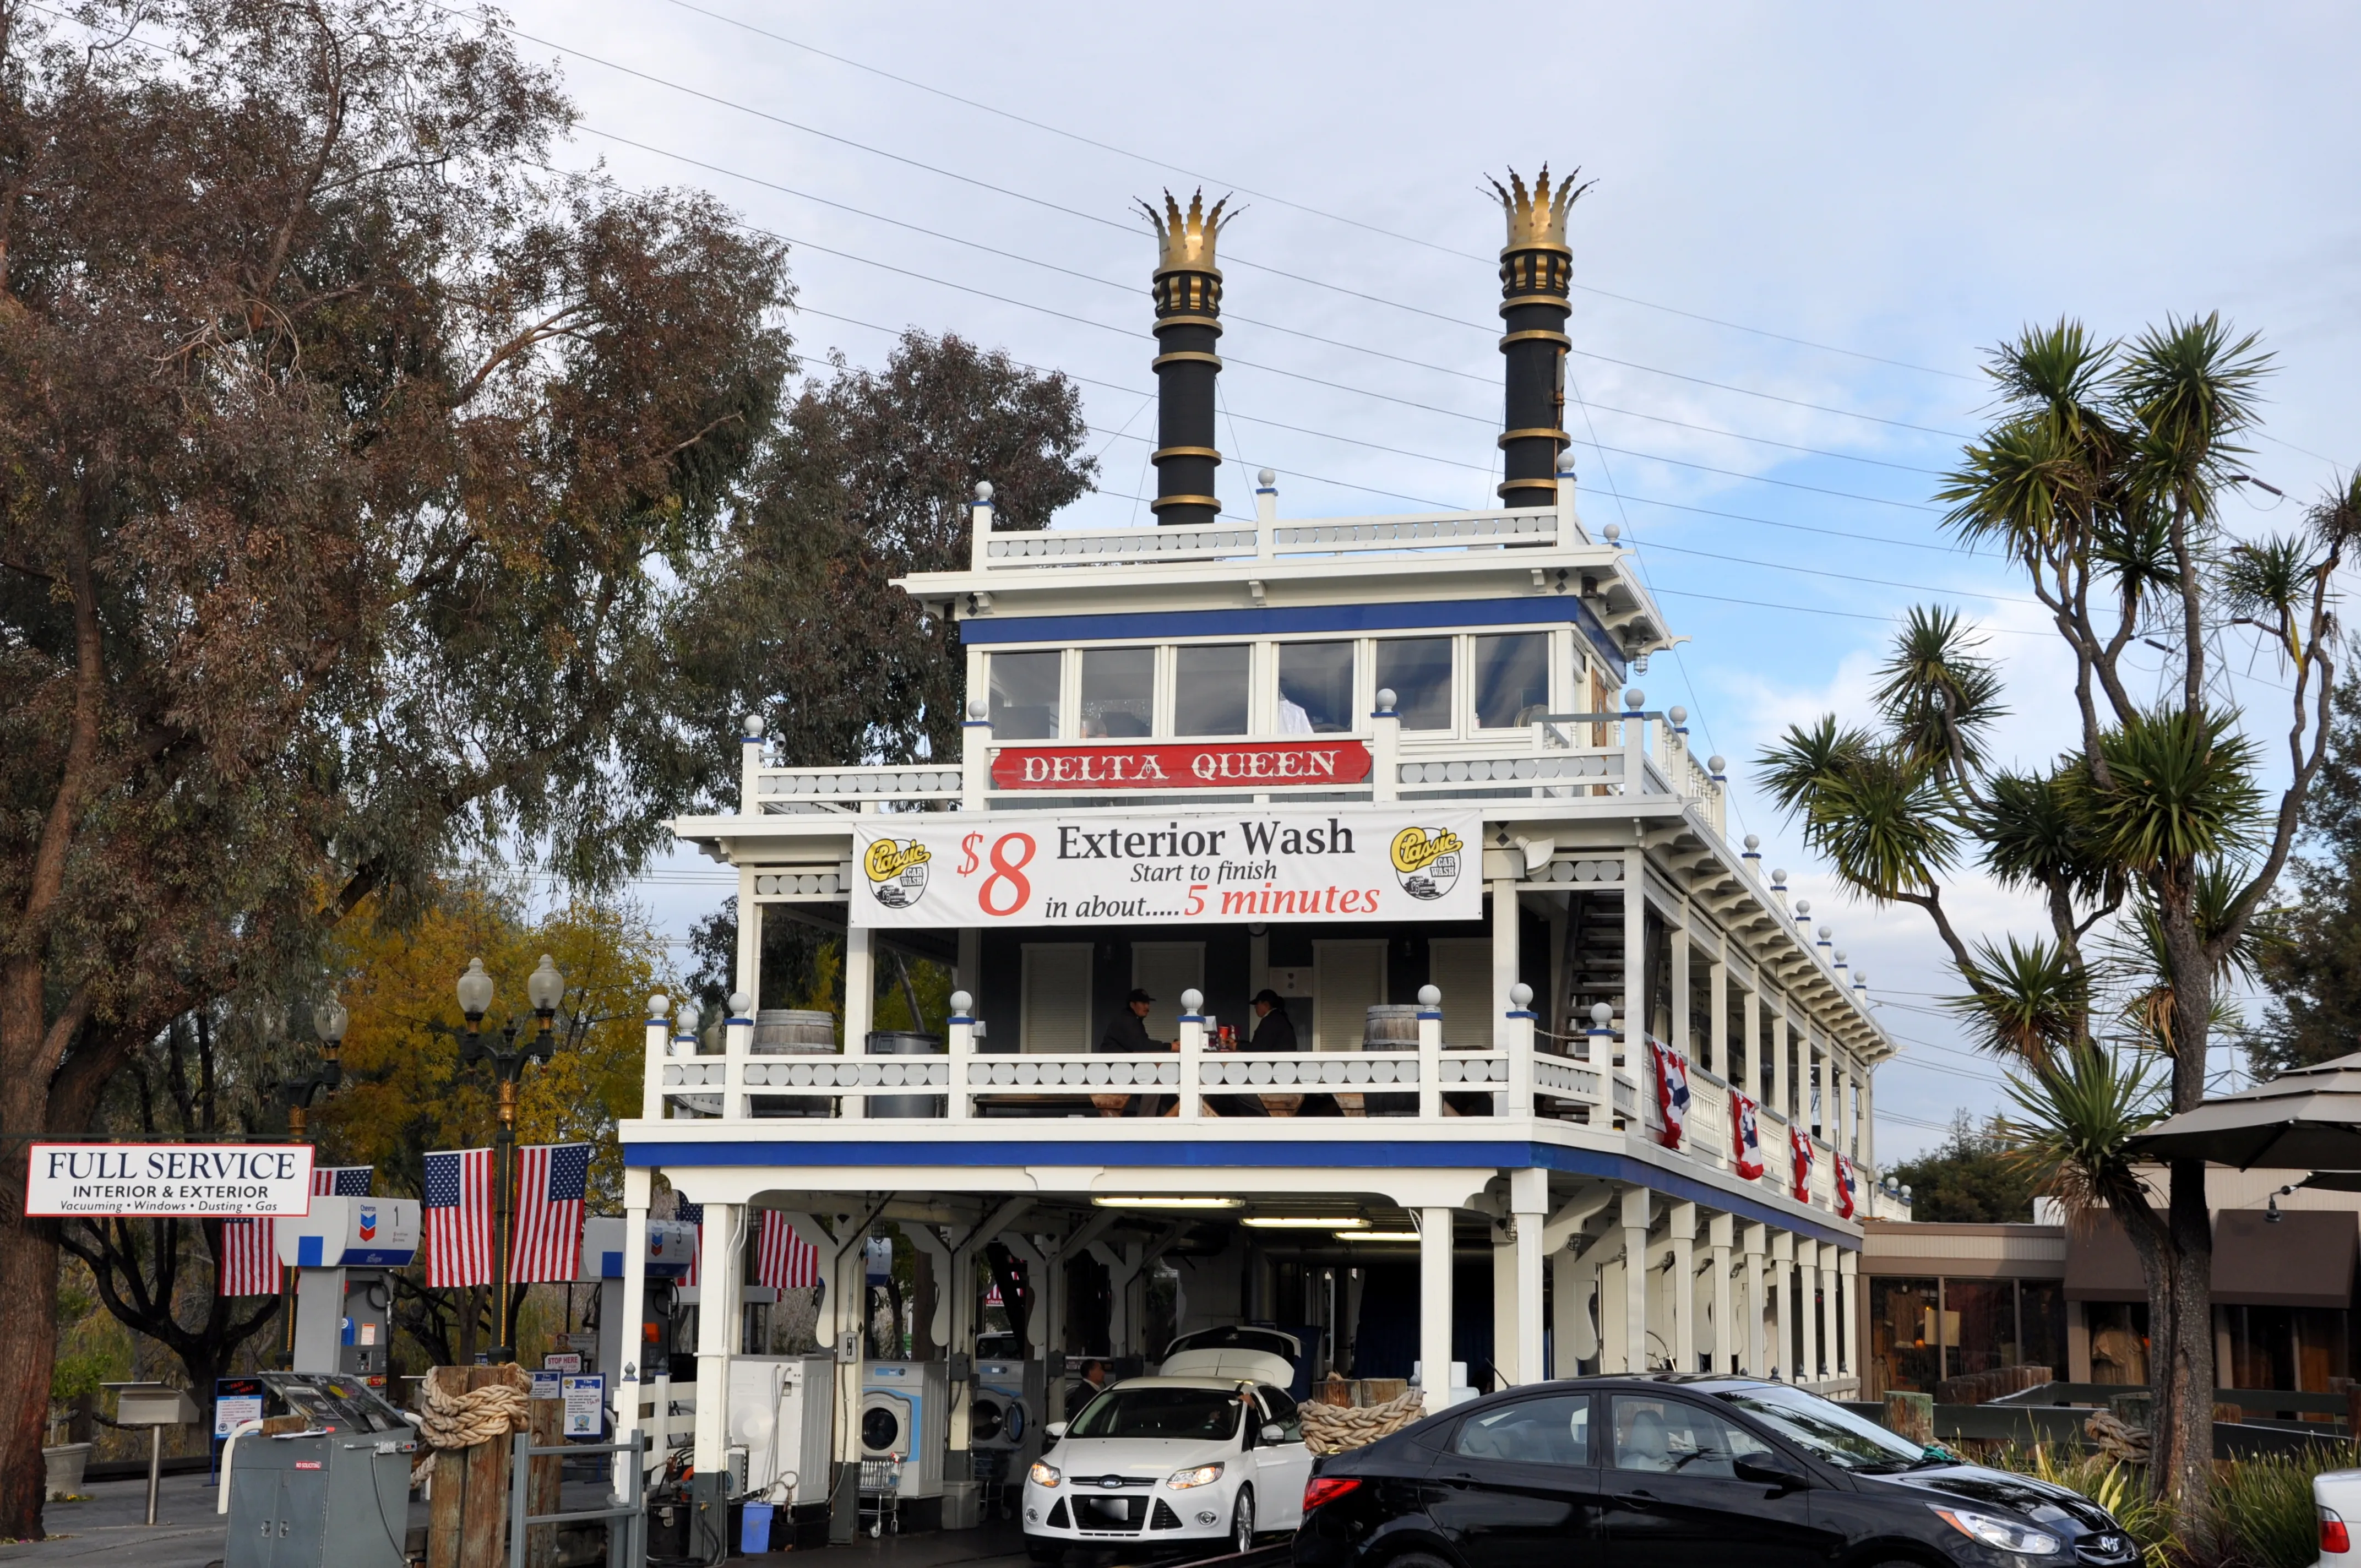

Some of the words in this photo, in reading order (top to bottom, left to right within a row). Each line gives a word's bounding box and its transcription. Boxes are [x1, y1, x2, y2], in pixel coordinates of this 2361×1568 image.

[1021, 754, 1169, 782] DELTA
[1191, 749, 1341, 781] QUEEN
[1057, 822, 1225, 859] Exterior
[1239, 818, 1355, 855] Wash
[1390, 826, 1464, 873] Classic
[864, 839, 931, 883] Classic
[1437, 857, 1455, 867] CAR
[900, 876, 923, 887] WASH
[906, 867, 923, 876] CAR
[957, 831, 1036, 916] $8
[1130, 863, 1184, 882] Start
[1190, 864, 1210, 881] to
[1217, 860, 1277, 884] finish
[1430, 867, 1455, 877] WASH
[1046, 897, 1067, 918] in
[1184, 885, 1207, 916] 5
[1221, 883, 1380, 914] minutes
[47, 1152, 137, 1179] FULL
[147, 1152, 295, 1180] SERVICE
[73, 1185, 156, 1197] INTERIOR
[162, 1186, 174, 1197] &
[180, 1186, 268, 1198] EXTERIOR
[61, 1201, 122, 1213] Vacuuming
[134, 1200, 186, 1211] Windows
[199, 1201, 243, 1213] Dusting
[255, 1201, 278, 1211] Gas
[676, 1227, 682, 1244] 3
[238, 1385, 254, 1393] WAX
